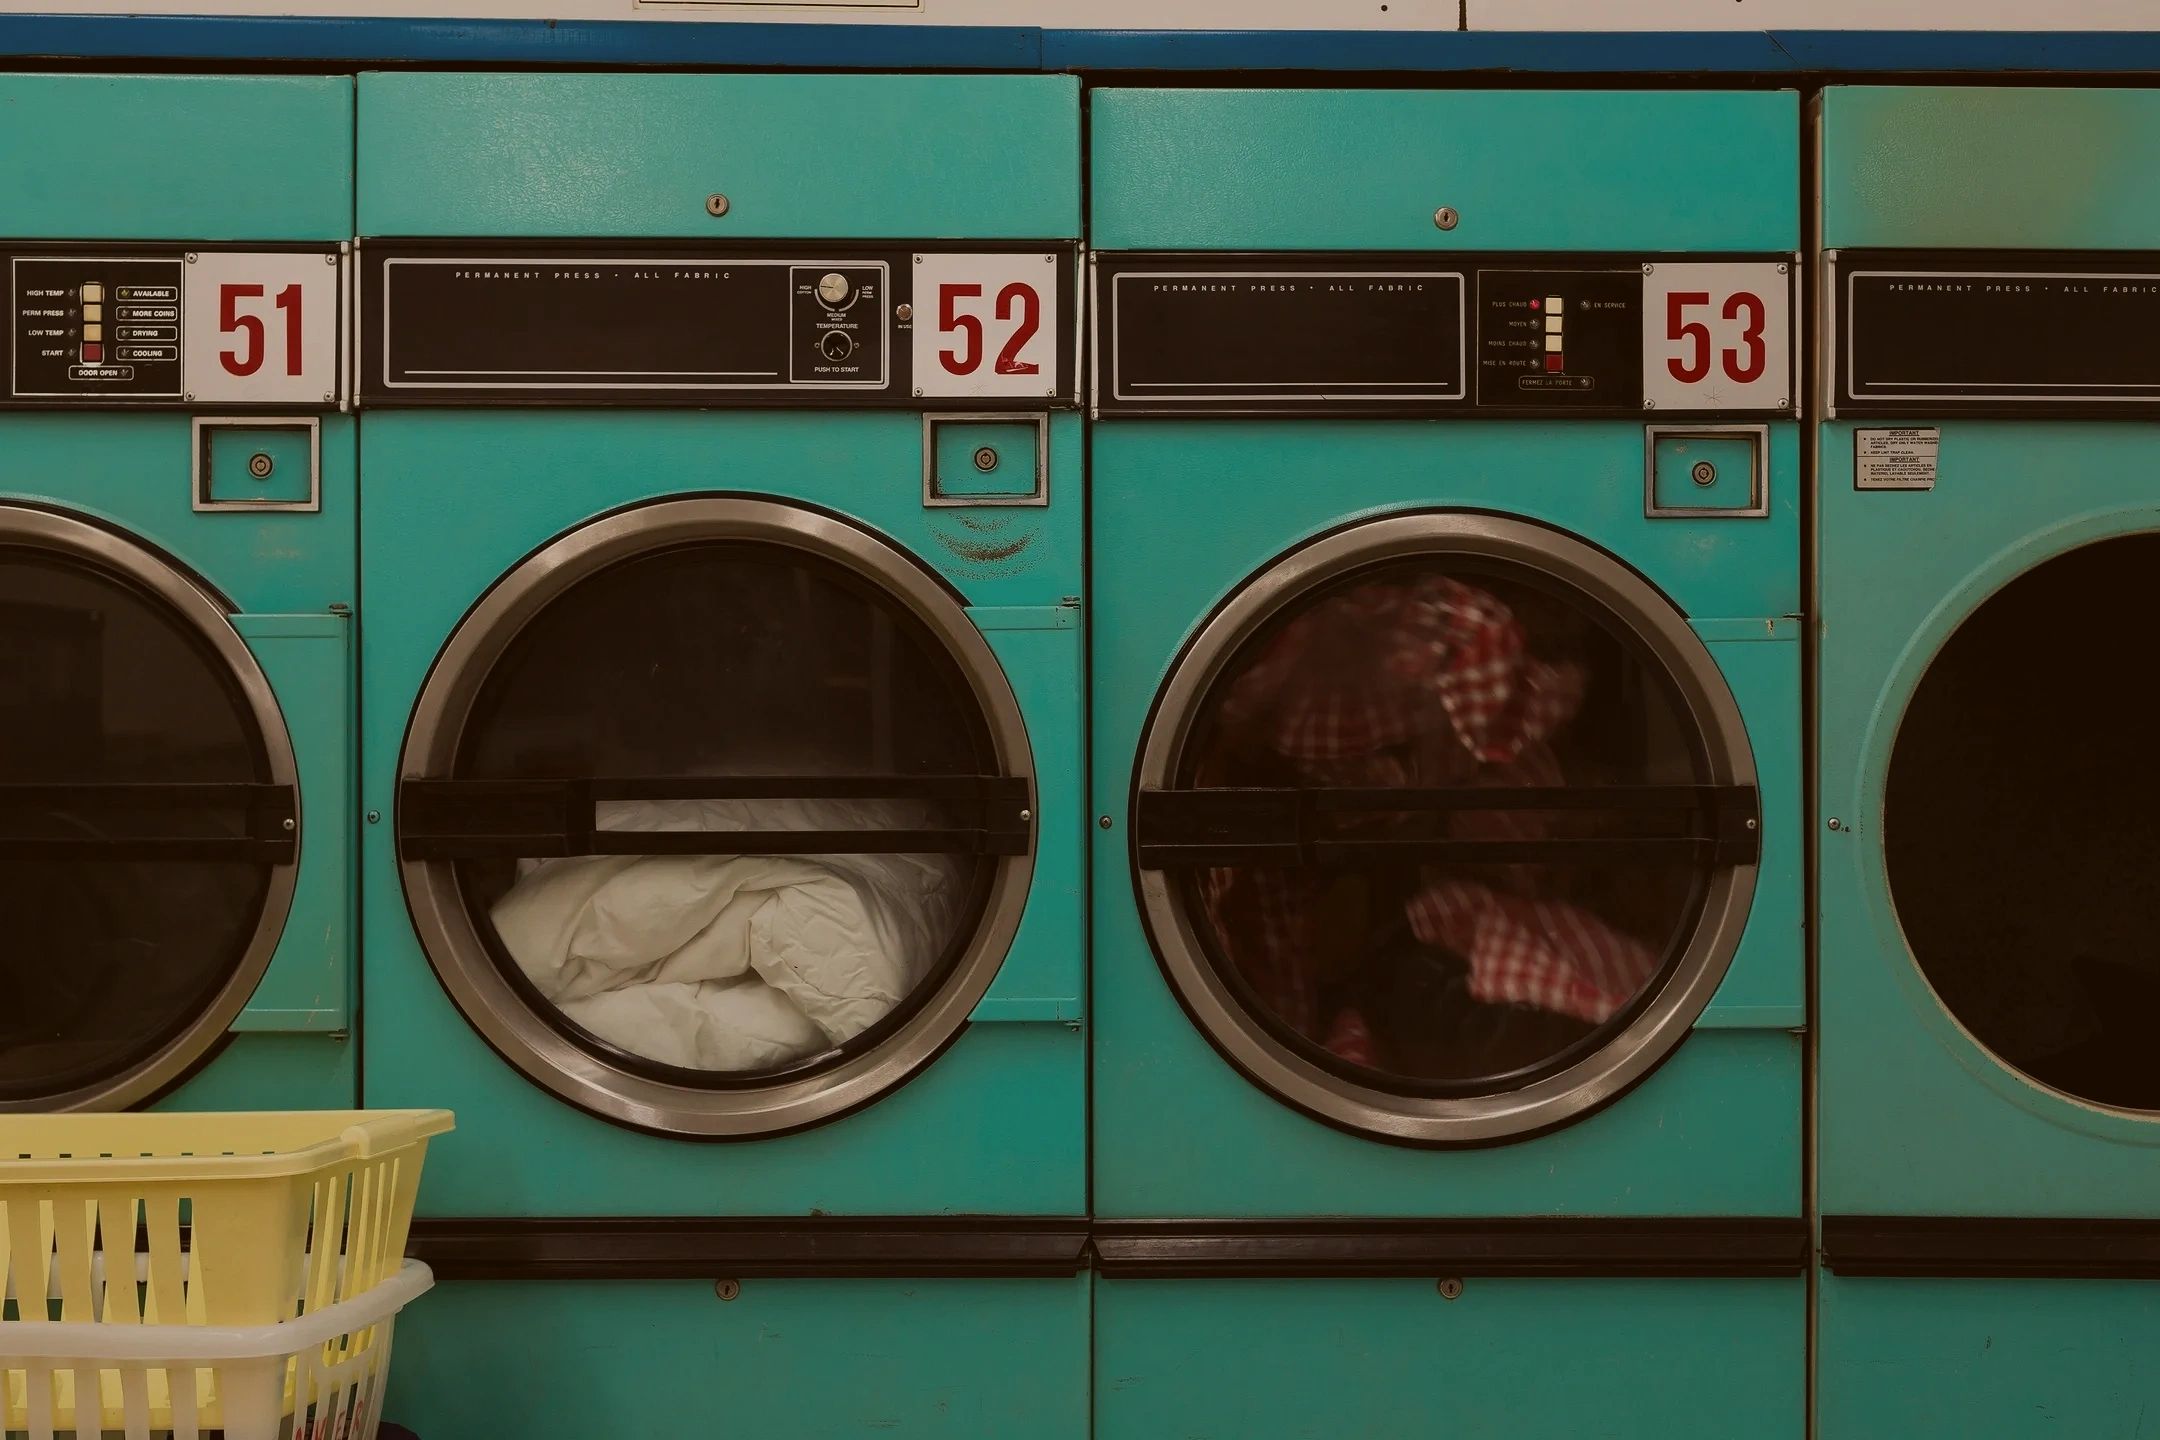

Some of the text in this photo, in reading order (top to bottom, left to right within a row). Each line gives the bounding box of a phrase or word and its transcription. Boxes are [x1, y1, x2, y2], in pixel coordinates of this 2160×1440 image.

[220, 284, 302, 376] 51
[939, 282, 1040, 376] 52
[1667, 292, 1766, 384] 53
